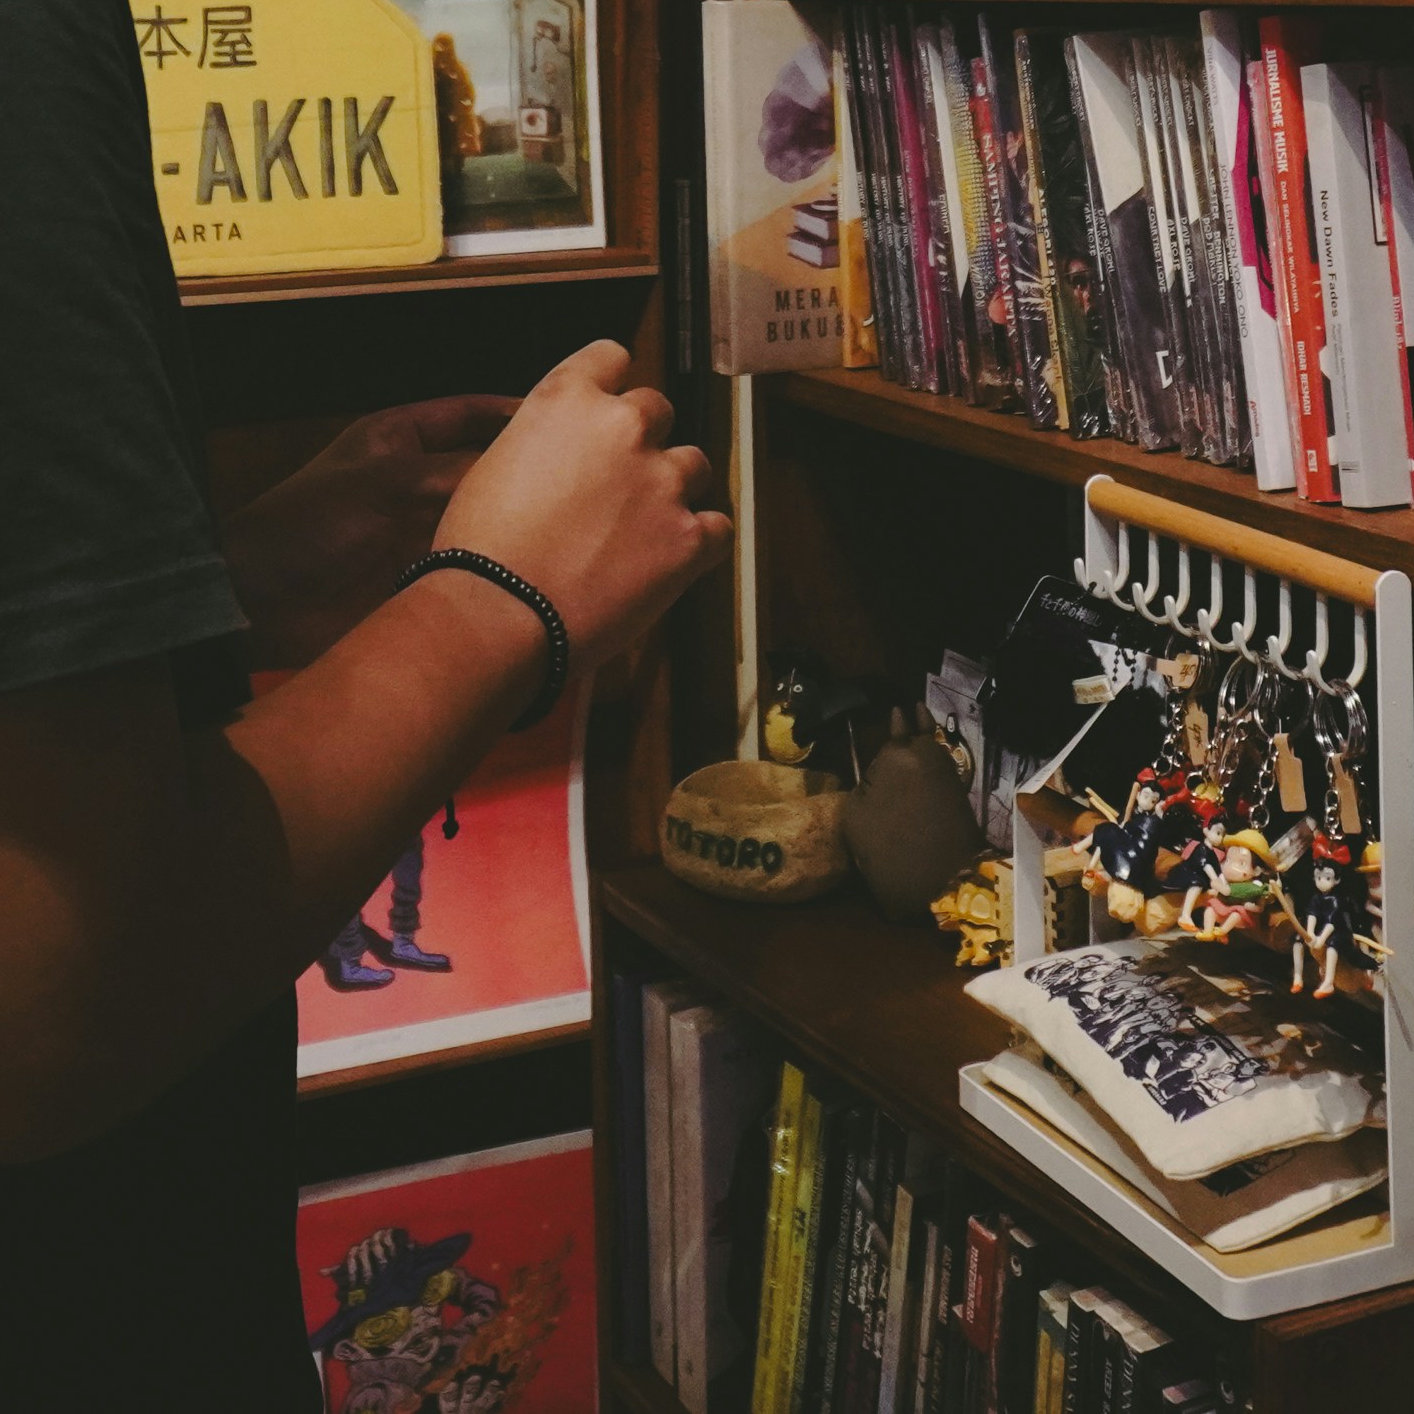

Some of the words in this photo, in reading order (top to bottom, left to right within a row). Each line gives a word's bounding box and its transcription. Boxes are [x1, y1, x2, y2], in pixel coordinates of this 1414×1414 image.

[134, 5, 258, 70] 本屋
[1266, 49, 1285, 127] JURNALISME
[1274, 132, 1288, 173] MUSIK
[1320, 190, 1330, 219] New
[1323, 227, 1333, 268] Dawn
[1328, 272, 1338, 317] Fades
[667, 817, 783, 873] TOTORO
